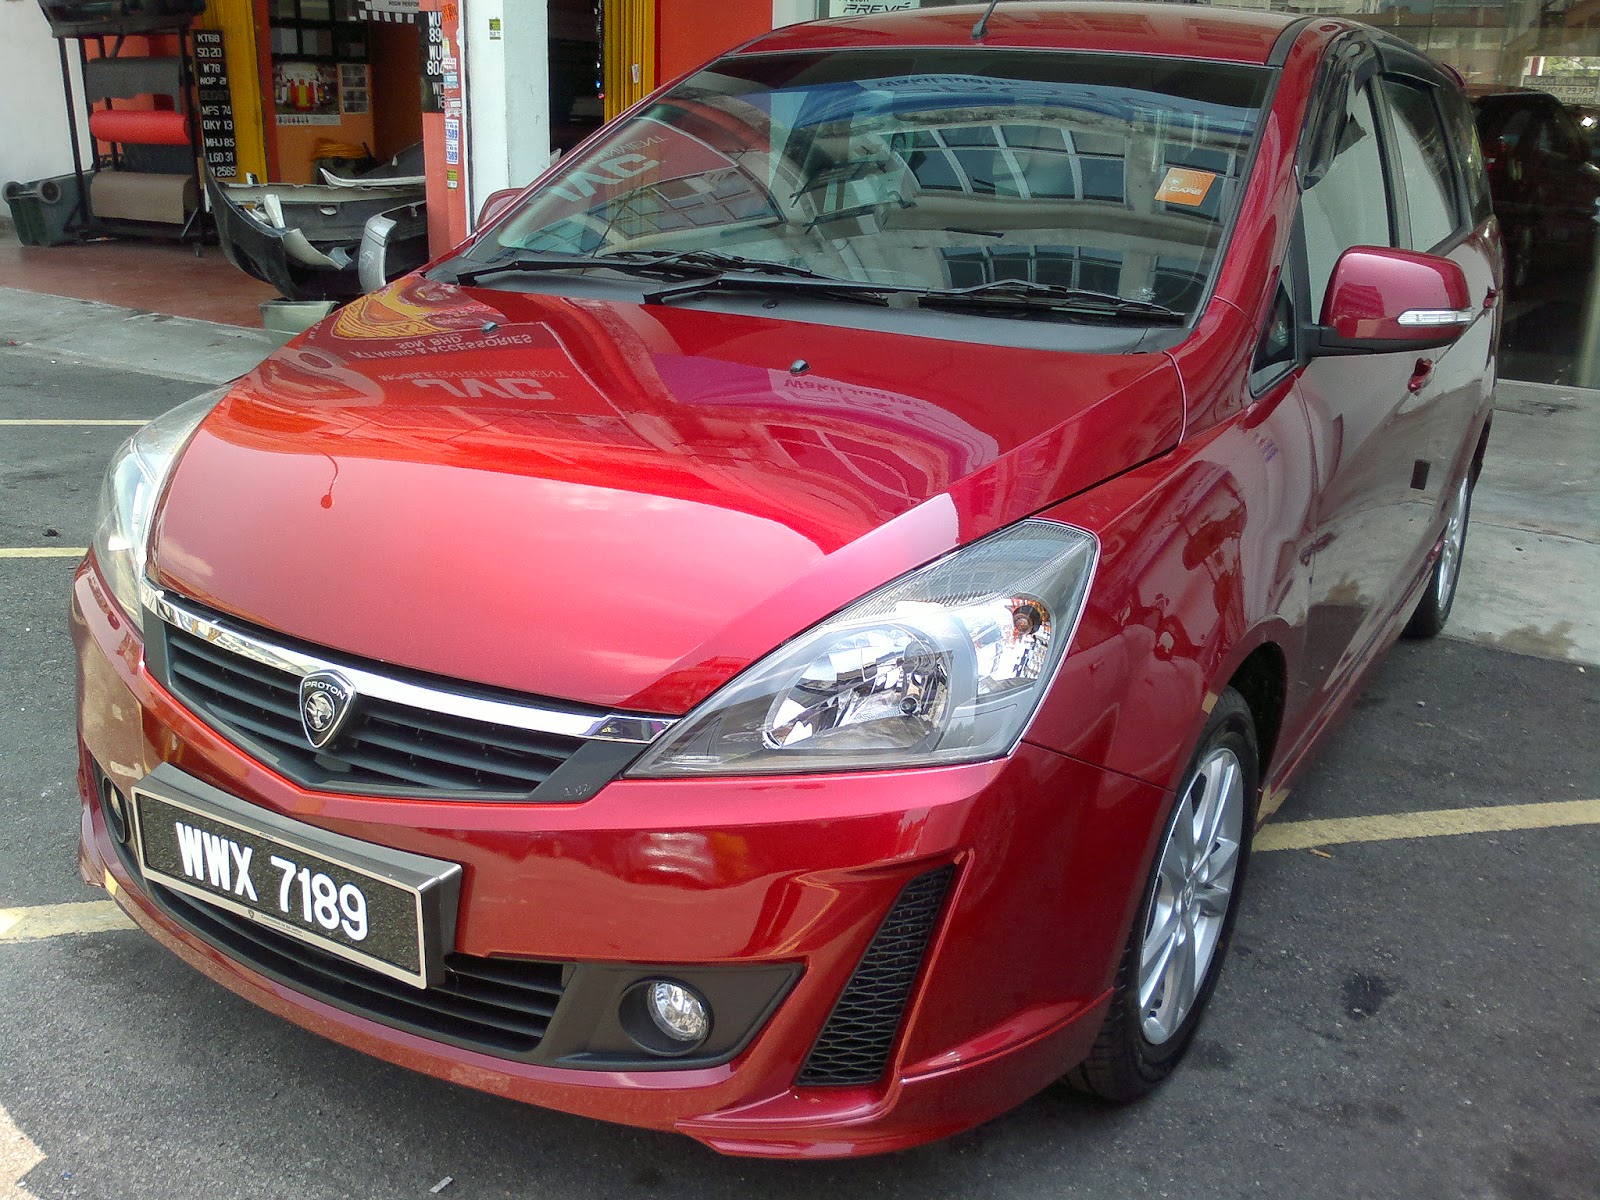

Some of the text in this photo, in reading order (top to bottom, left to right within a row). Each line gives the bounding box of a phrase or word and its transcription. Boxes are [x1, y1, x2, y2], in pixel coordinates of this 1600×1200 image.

[304, 680, 348, 700] PROTON
[175, 821, 370, 942] WWX 7189
